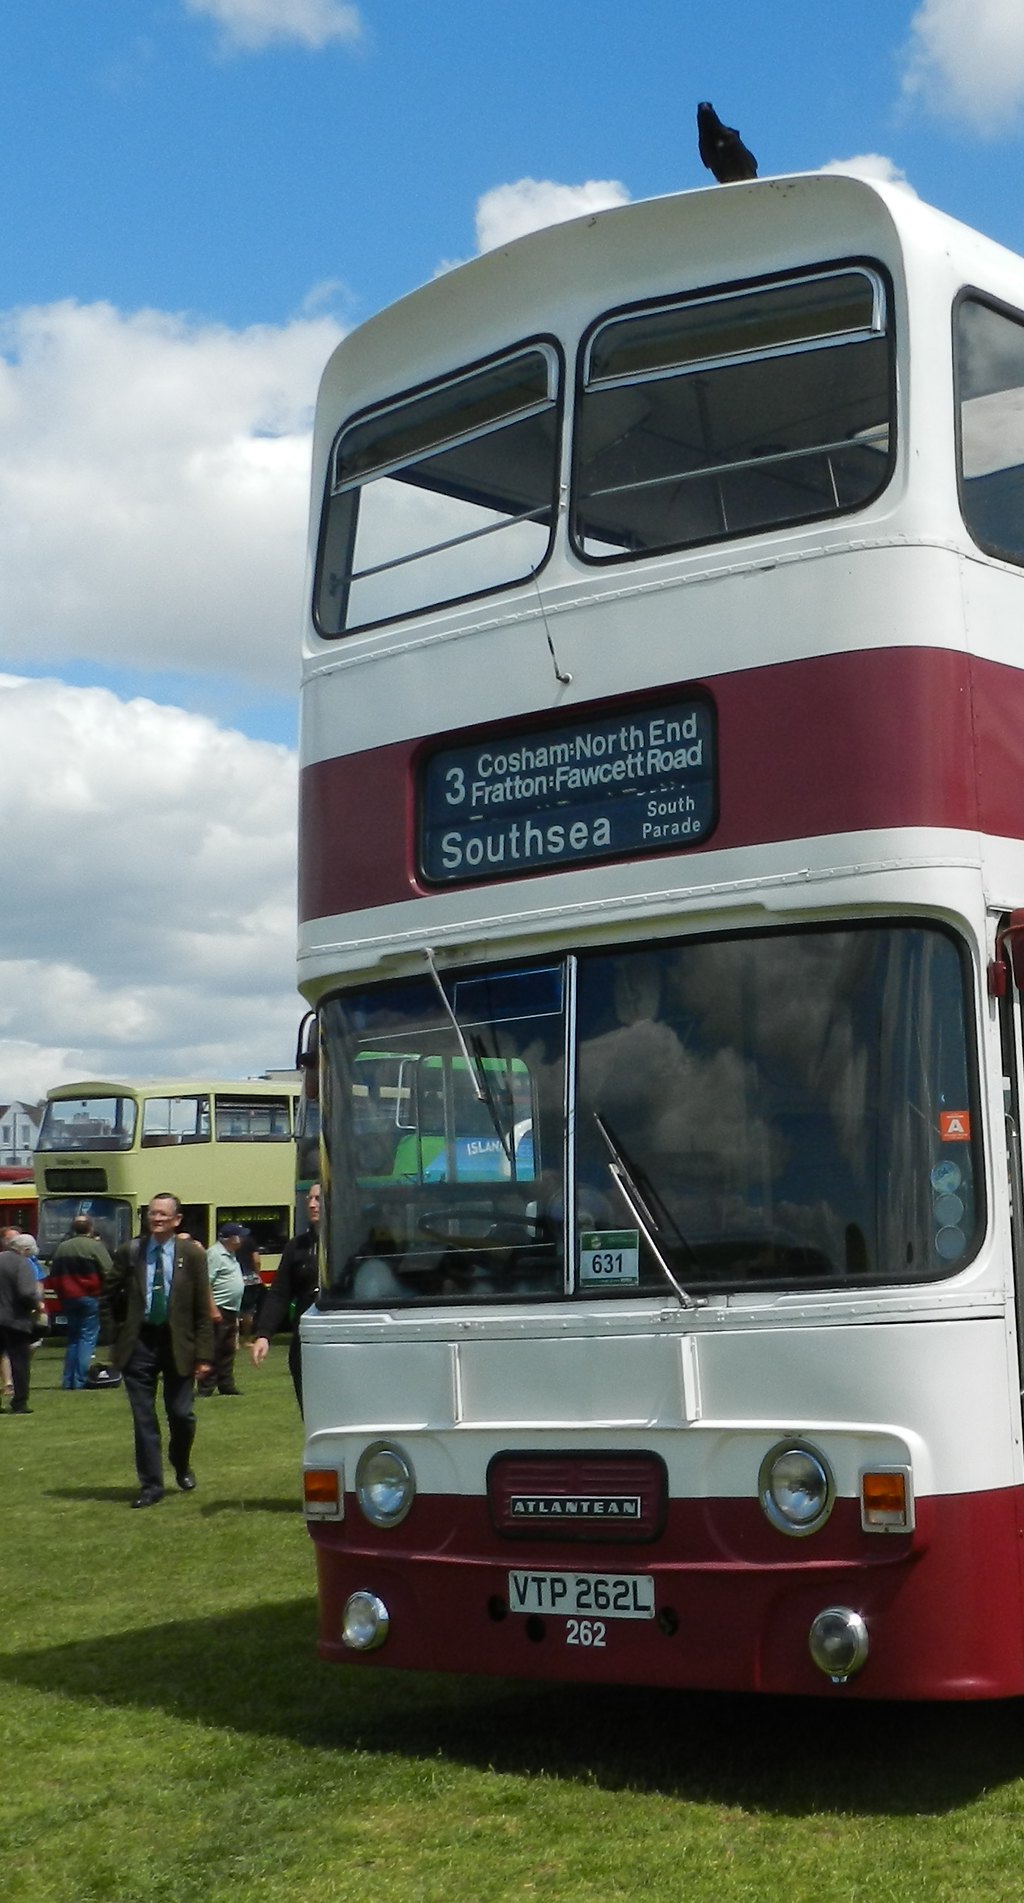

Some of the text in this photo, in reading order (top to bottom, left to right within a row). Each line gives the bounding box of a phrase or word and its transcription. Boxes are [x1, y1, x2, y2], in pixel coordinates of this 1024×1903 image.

[649, 712, 698, 746] End
[646, 740, 703, 775] Road
[445, 767, 465, 805] 3
[647, 796, 696, 818] South
[441, 817, 612, 869] Southsea
[642, 818, 701, 839] Parade
[467, 1140, 504, 1156] ISLAN
[592, 1253, 623, 1274] 631
[513, 1501, 636, 1513] ATLANTEAN
[513, 1574, 652, 1612] VTP 262L
[566, 1618, 607, 1647] 262
